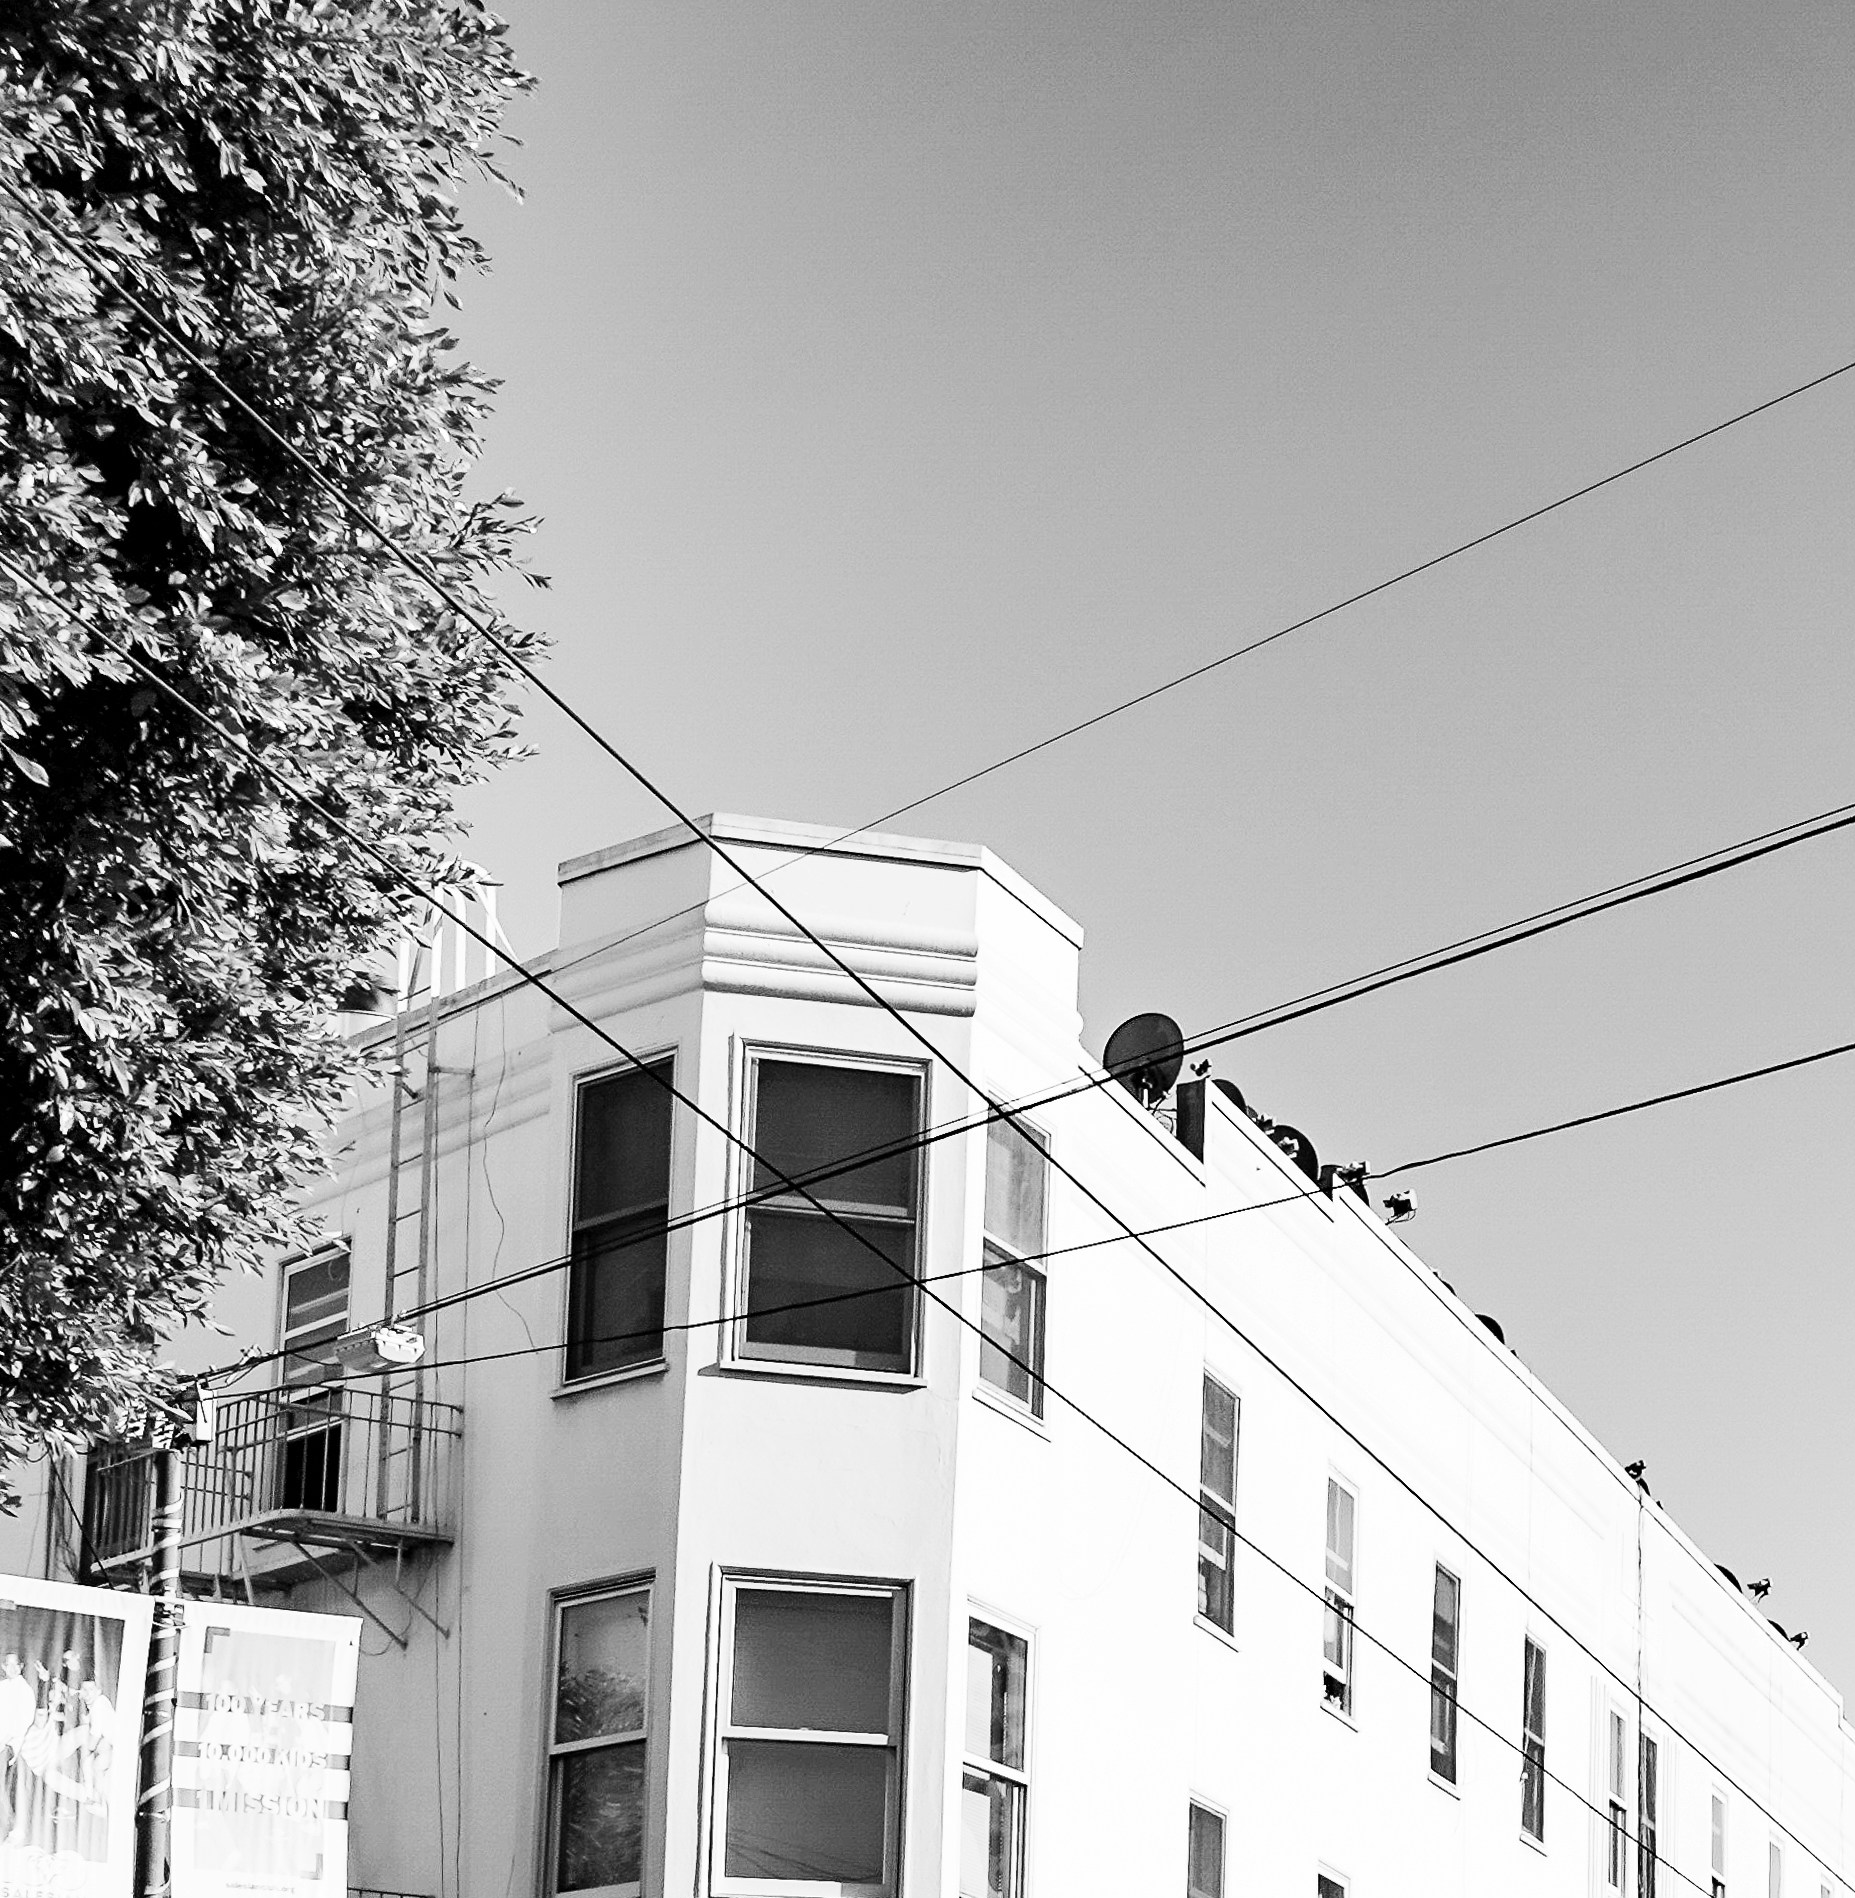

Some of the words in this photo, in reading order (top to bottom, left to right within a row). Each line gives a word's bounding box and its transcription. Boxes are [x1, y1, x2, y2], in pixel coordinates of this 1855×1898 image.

[206, 1692, 247, 1714] 100
[249, 1696, 326, 1721] YEARS
[274, 1748, 327, 1769] KIDS
[213, 1792, 324, 1819] MISSION
